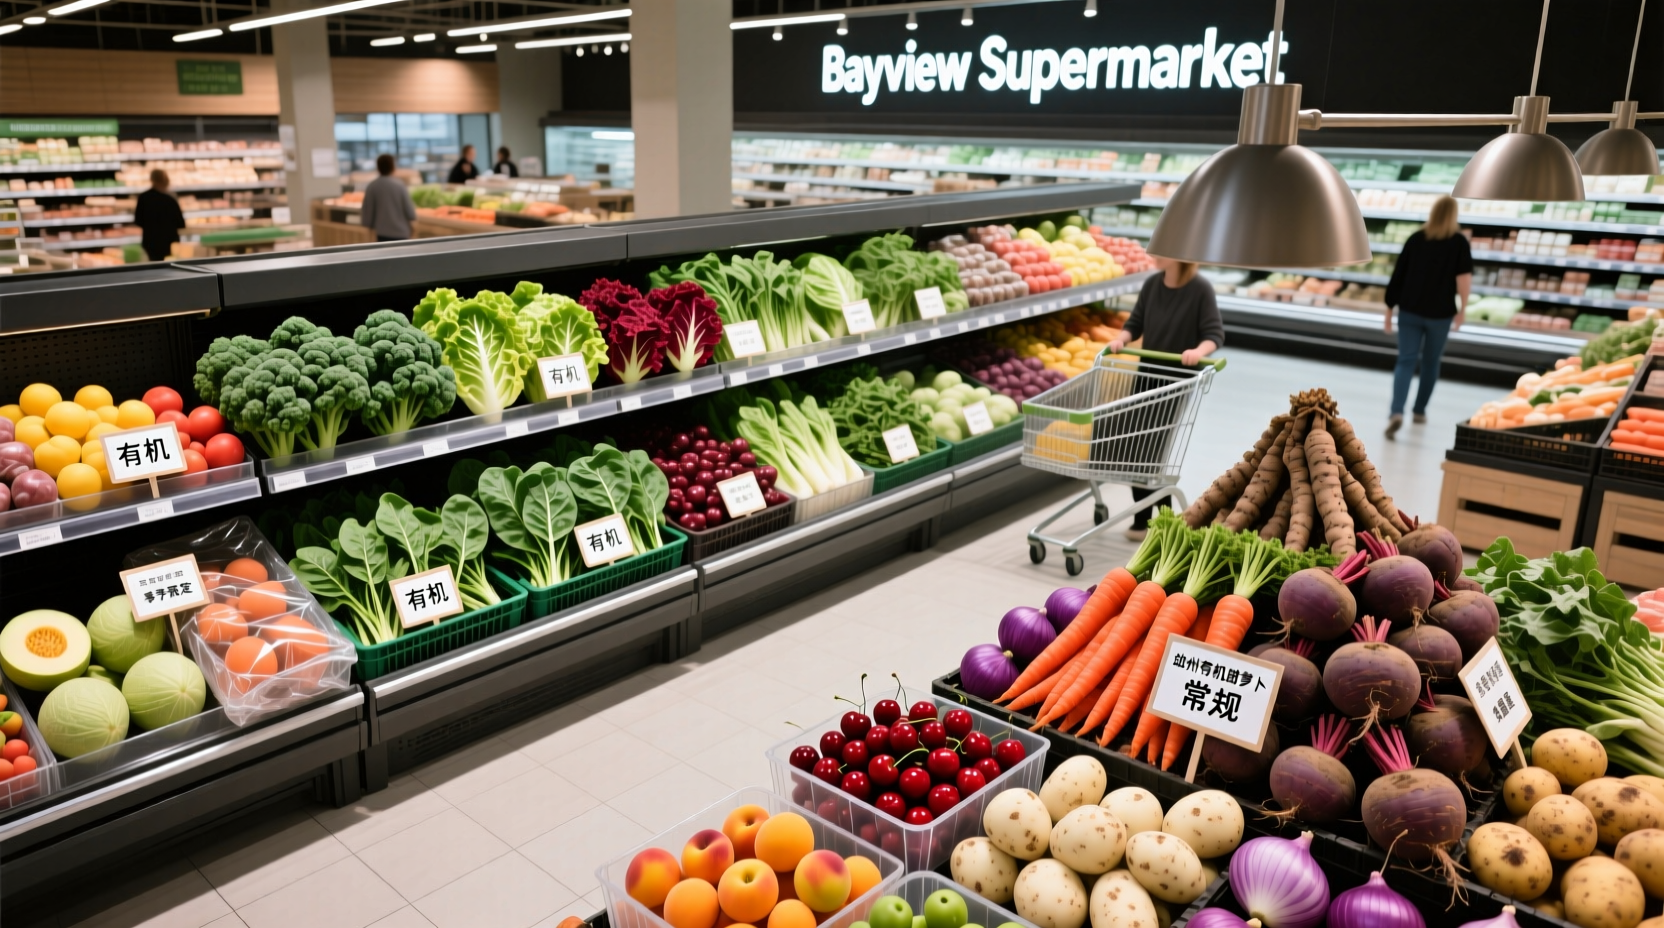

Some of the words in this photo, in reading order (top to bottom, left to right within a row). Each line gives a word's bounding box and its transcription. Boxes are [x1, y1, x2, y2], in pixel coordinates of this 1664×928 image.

[821, 38, 972, 105] Bayview
[978, 27, 1289, 104] Supermarket
[548, 364, 581, 384] 有机
[116, 437, 171, 468] 有机
[586, 528, 622, 552] 有机
[405, 582, 449, 611] 有机
[1181, 679, 1242, 722] 常规
